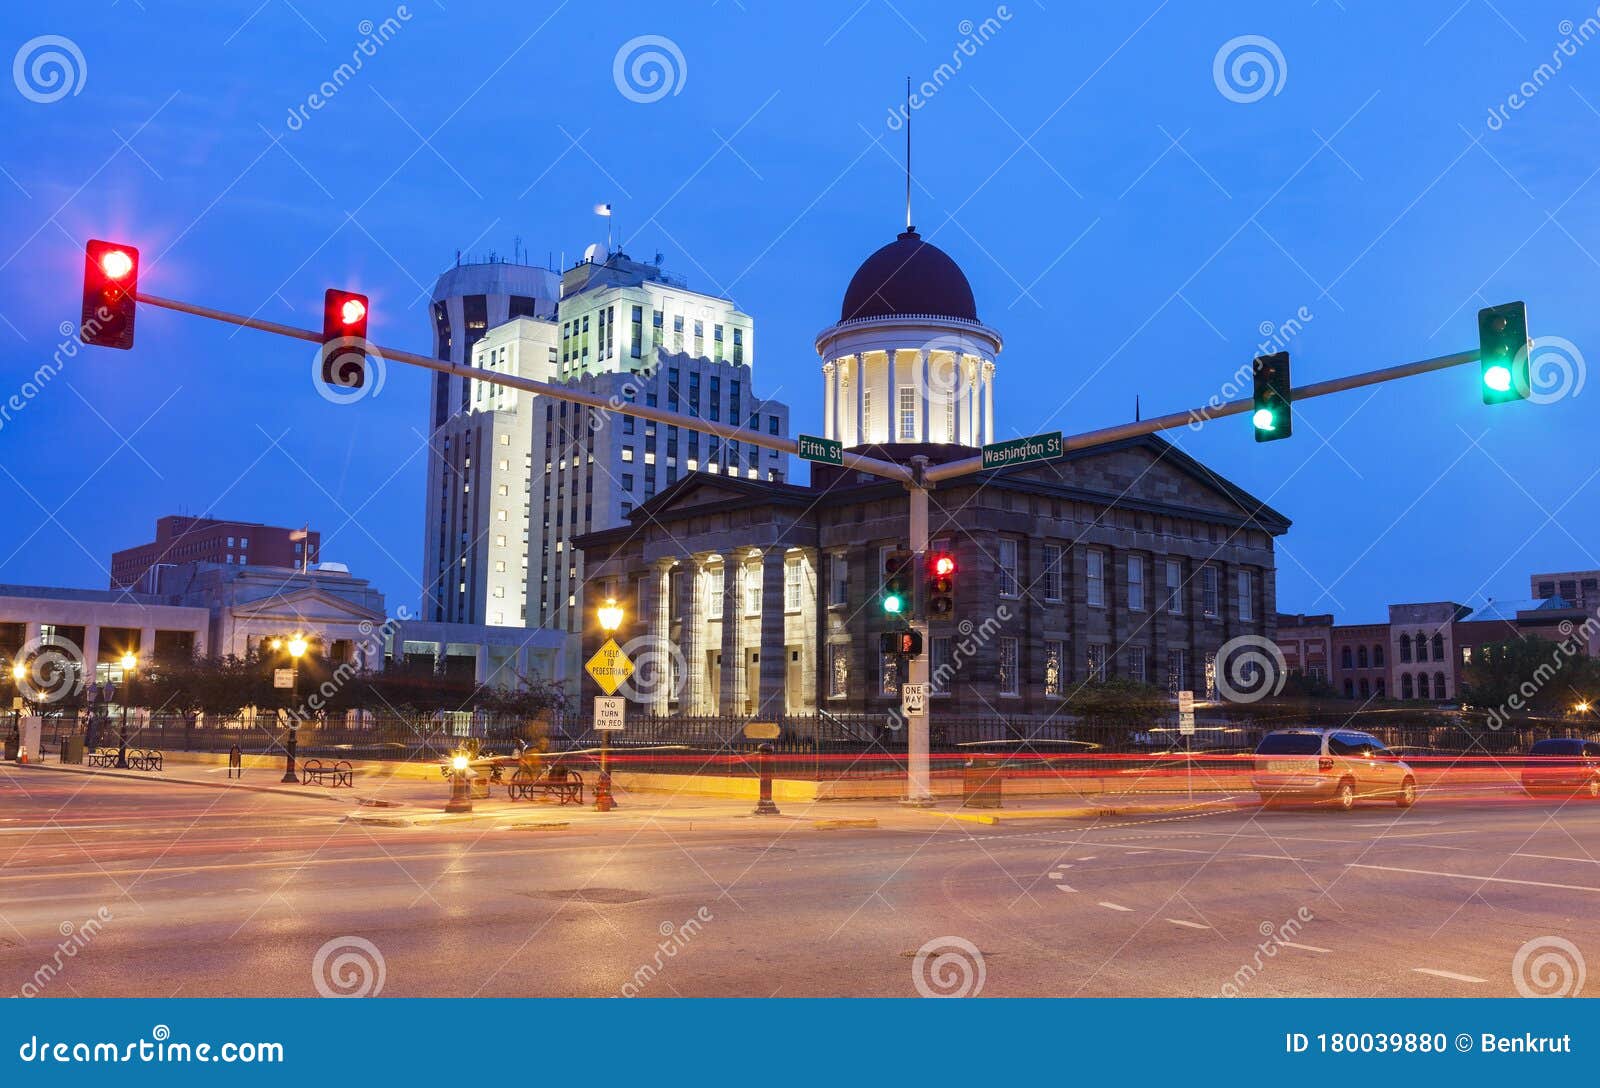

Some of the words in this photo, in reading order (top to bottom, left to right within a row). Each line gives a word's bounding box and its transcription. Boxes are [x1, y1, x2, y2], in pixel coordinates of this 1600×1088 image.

[800, 440, 826, 457] Fifth
[829, 446, 841, 459] St
[984, 443, 1044, 463] Washington
[1047, 439, 1060, 451] St
[592, 667, 629, 676] PEDESTRIANS
[608, 719, 622, 727] RED
